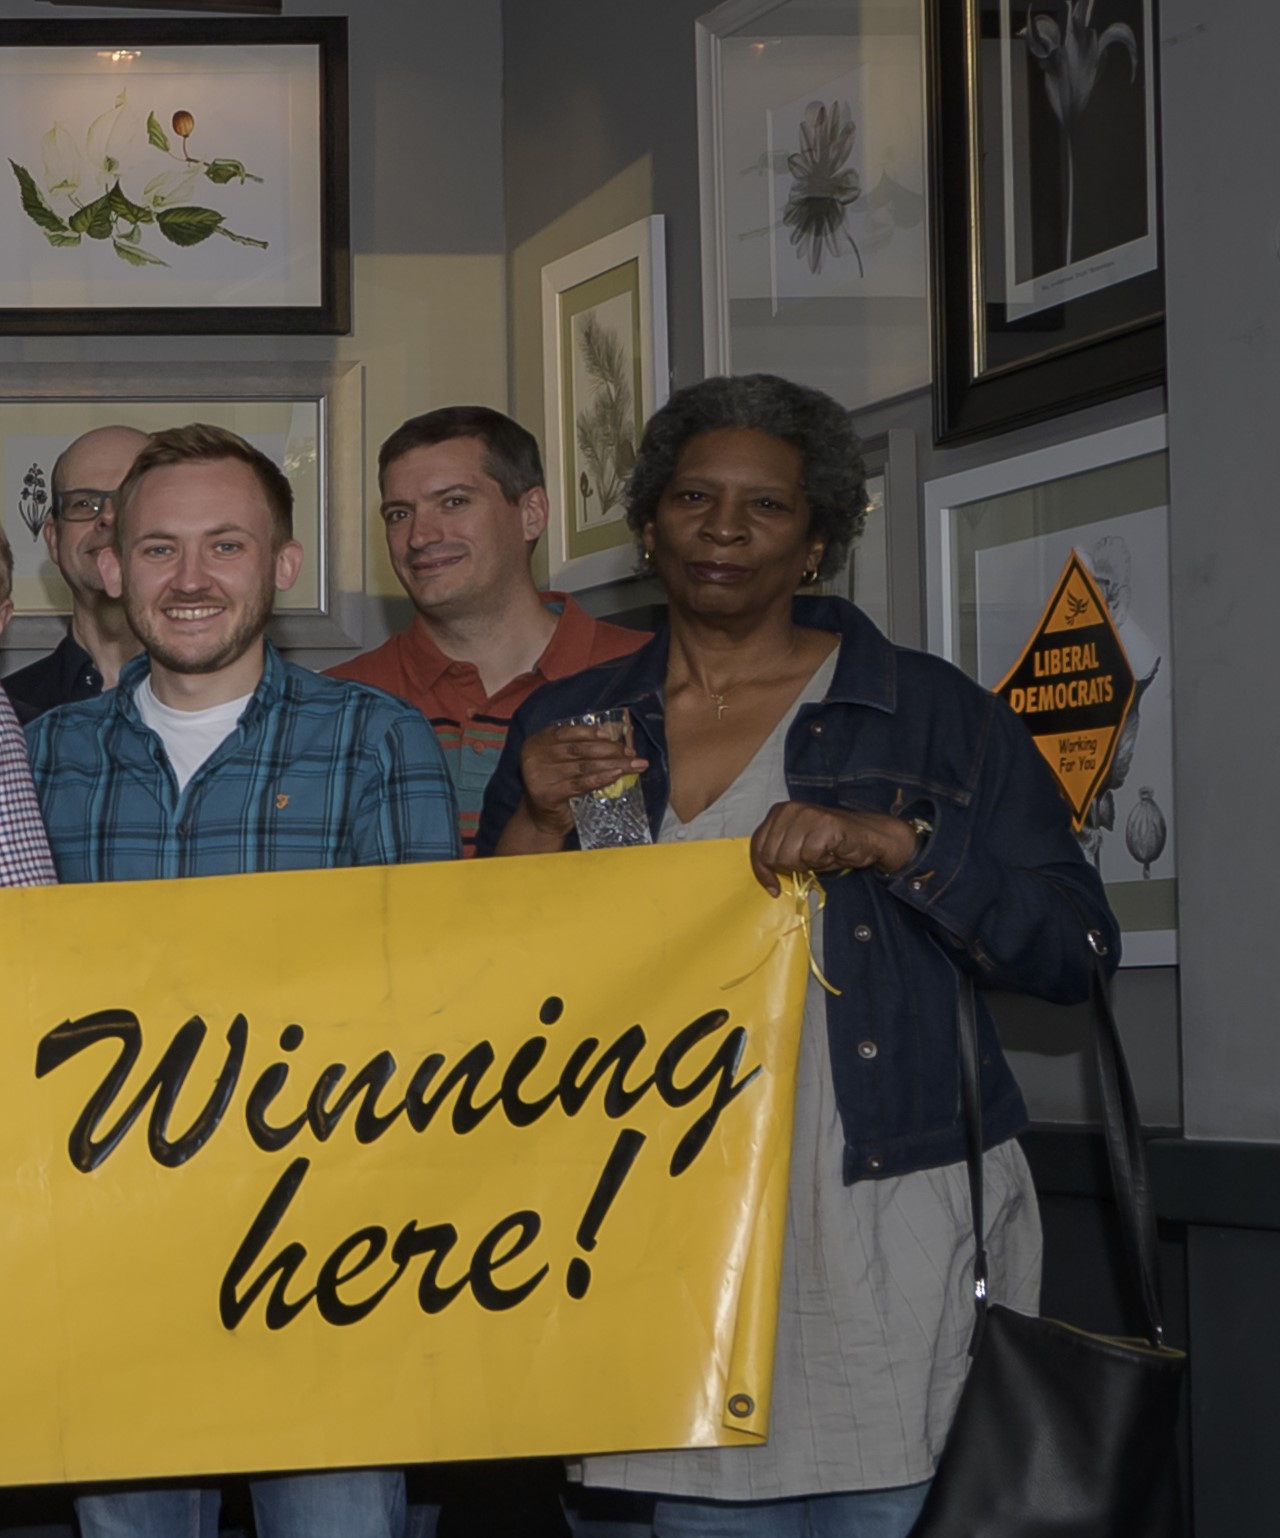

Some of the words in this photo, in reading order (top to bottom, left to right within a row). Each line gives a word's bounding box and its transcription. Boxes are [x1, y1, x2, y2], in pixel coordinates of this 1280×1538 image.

[1034, 642, 1099, 677] LIBERAL
[1010, 675, 1114, 713] DEMOCRATS
[1058, 736, 1097, 755] Working
[1058, 757, 1075, 774] For
[1078, 756, 1096, 772] You
[35, 996, 763, 1177] Winning
[219, 1129, 647, 1331] here!
